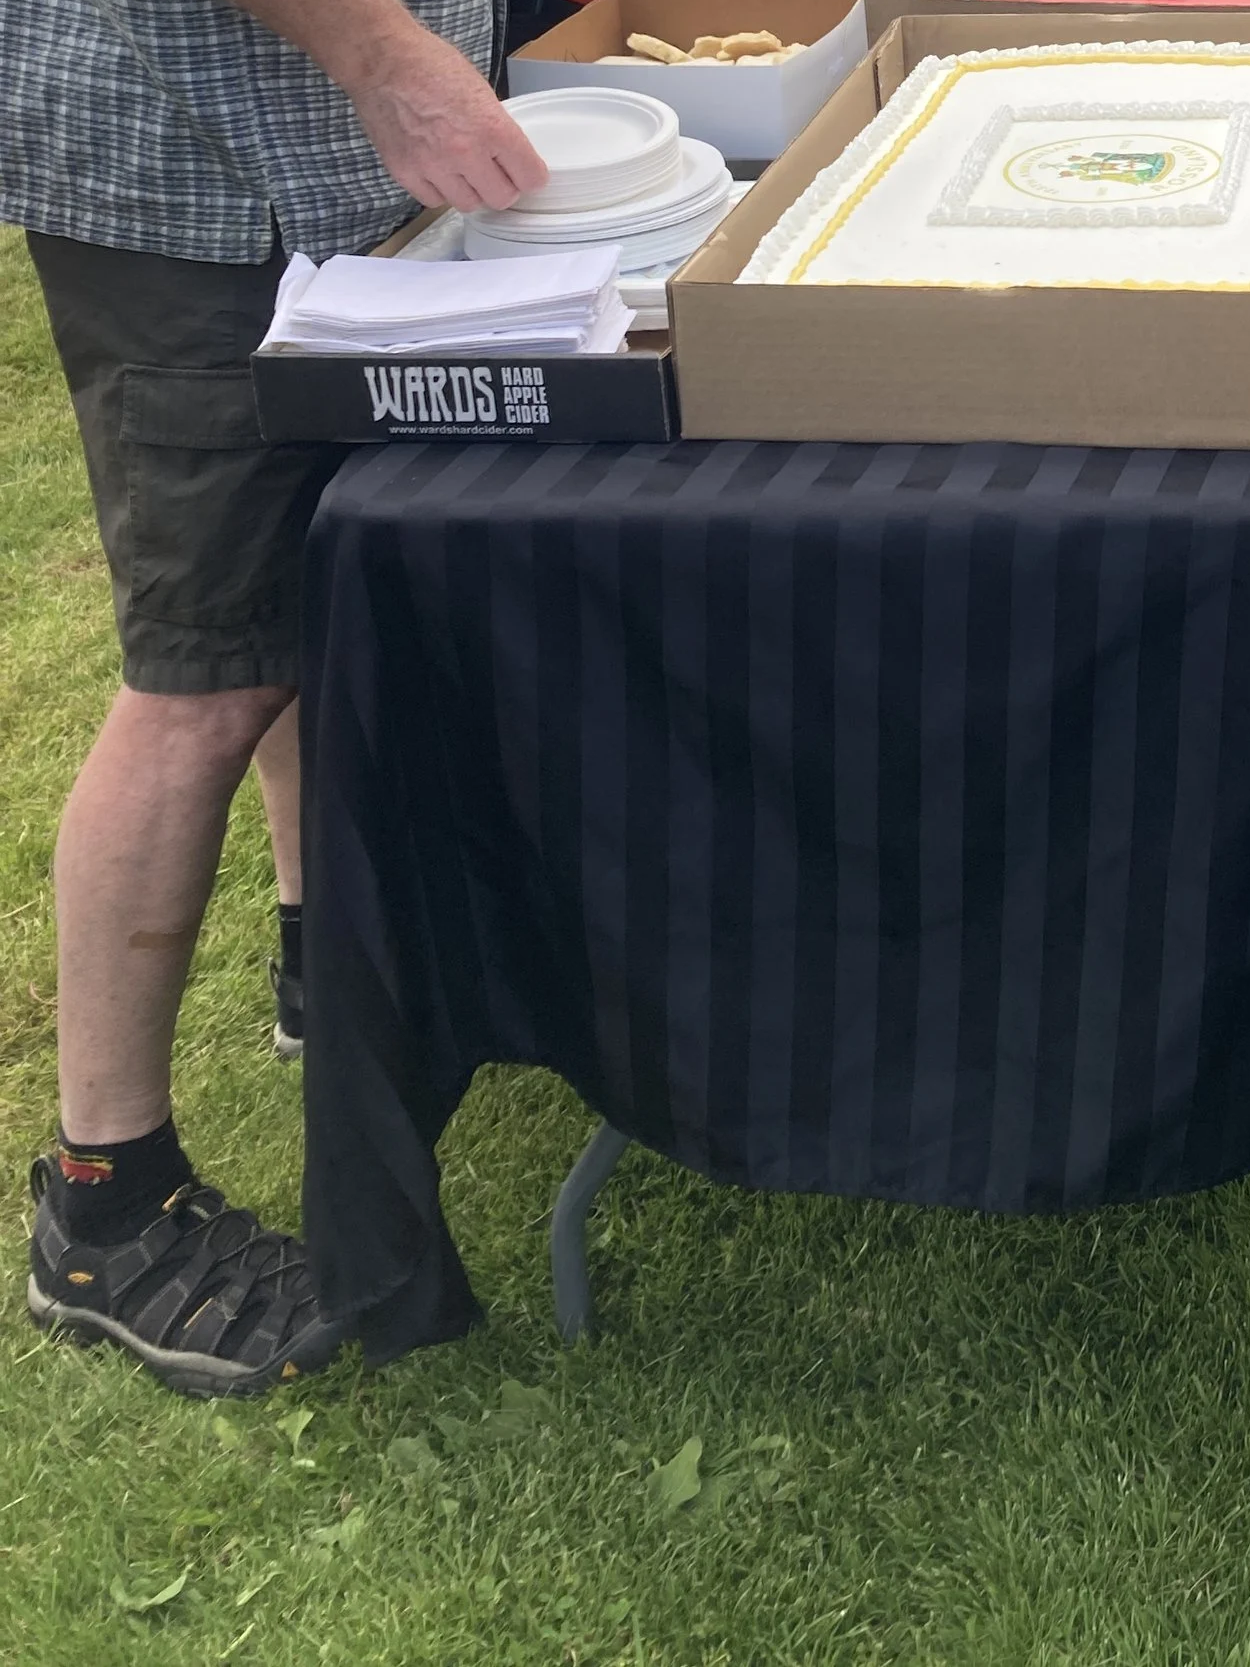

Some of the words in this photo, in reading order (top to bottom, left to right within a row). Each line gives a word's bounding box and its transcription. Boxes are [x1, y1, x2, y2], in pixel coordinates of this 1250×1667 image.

[501, 367, 543, 386] HARD
[363, 366, 497, 422] WARDS
[503, 387, 548, 405] APPLE
[505, 405, 550, 424] CIDER
